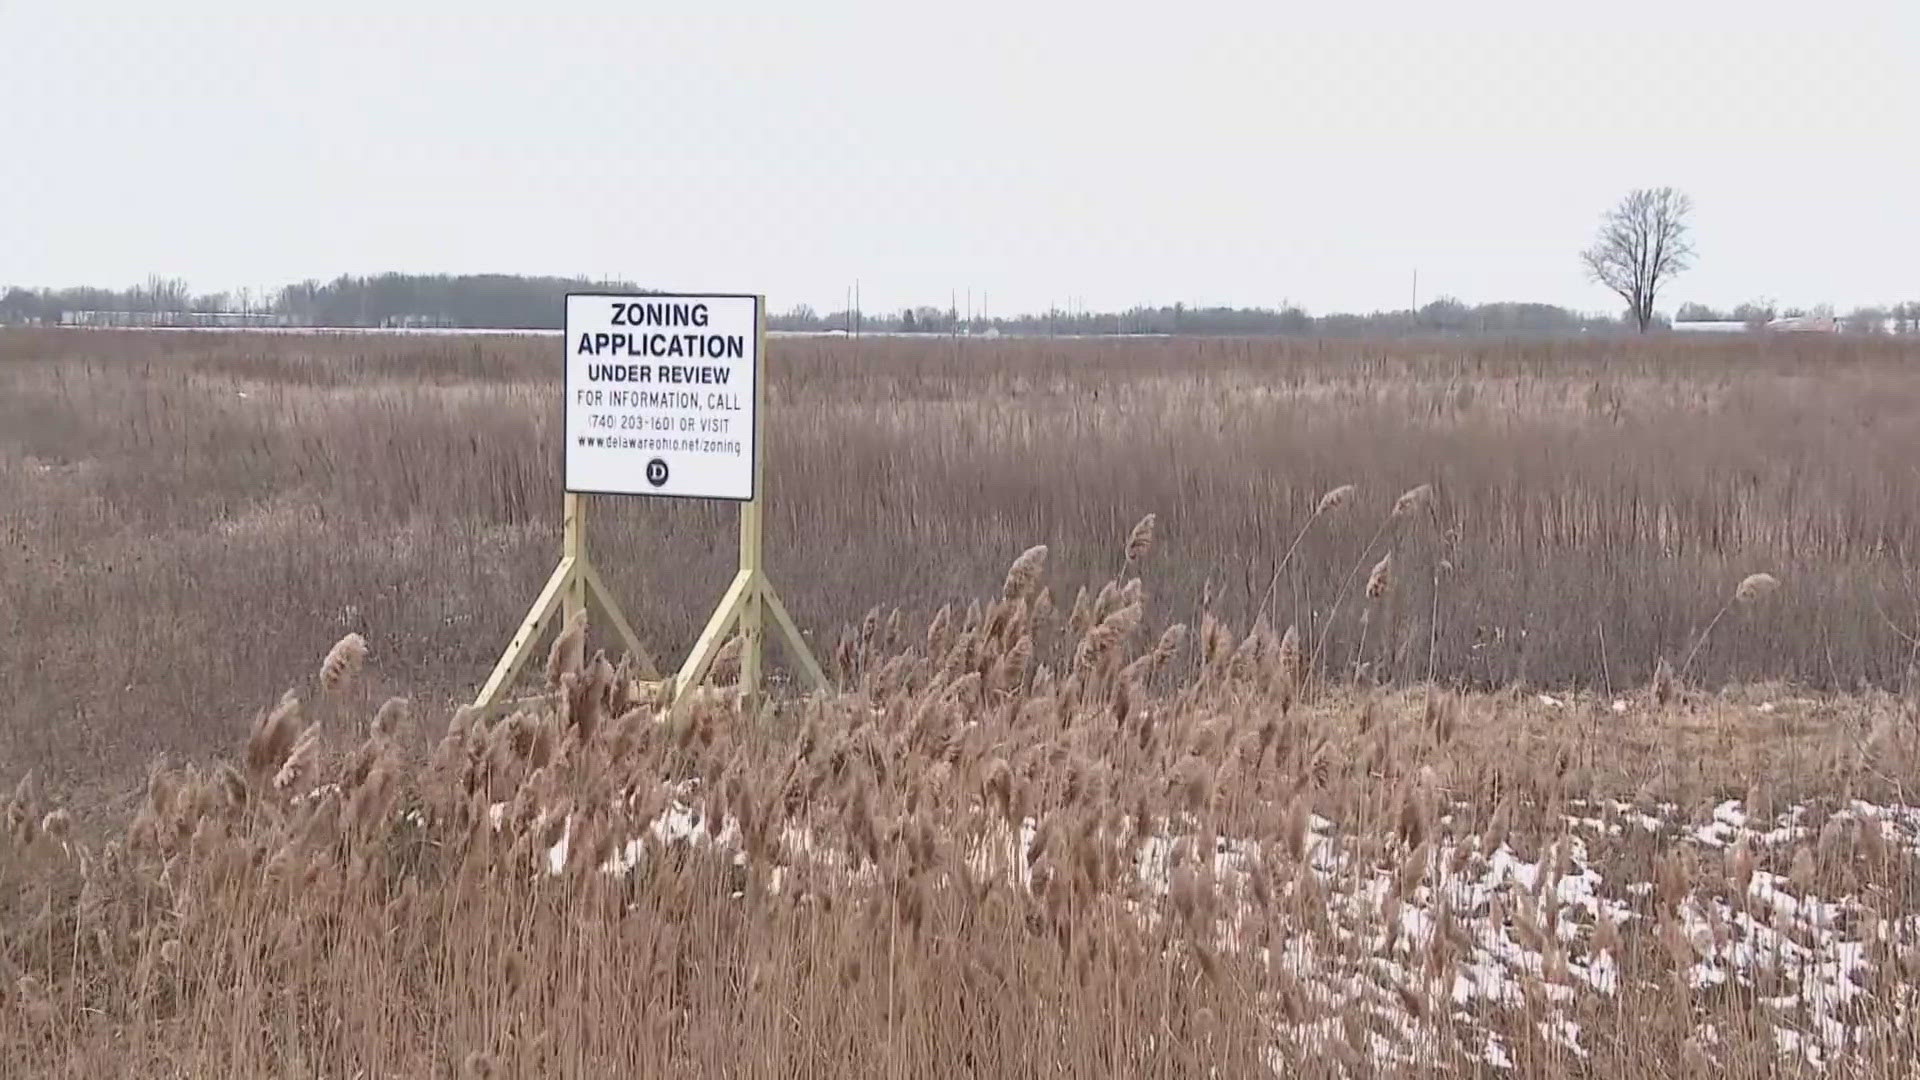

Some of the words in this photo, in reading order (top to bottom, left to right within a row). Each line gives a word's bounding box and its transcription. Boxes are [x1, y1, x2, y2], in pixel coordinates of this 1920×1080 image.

[611, 303, 709, 327] ZONING
[578, 333, 744, 358] APPLICATION
[588, 364, 652, 383] UNDER
[658, 365, 730, 384] REVIEW
[578, 390, 603, 406] FOR
[609, 391, 702, 411] INFORMATION,
[707, 393, 741, 411] CALL
[588, 415, 617, 429] (740)
[621, 416, 675, 431] 203-1601
[680, 417, 696, 432] OR
[700, 419, 729, 433] VISIT
[578, 436, 742, 457] www.delawareohio.net/zoning
